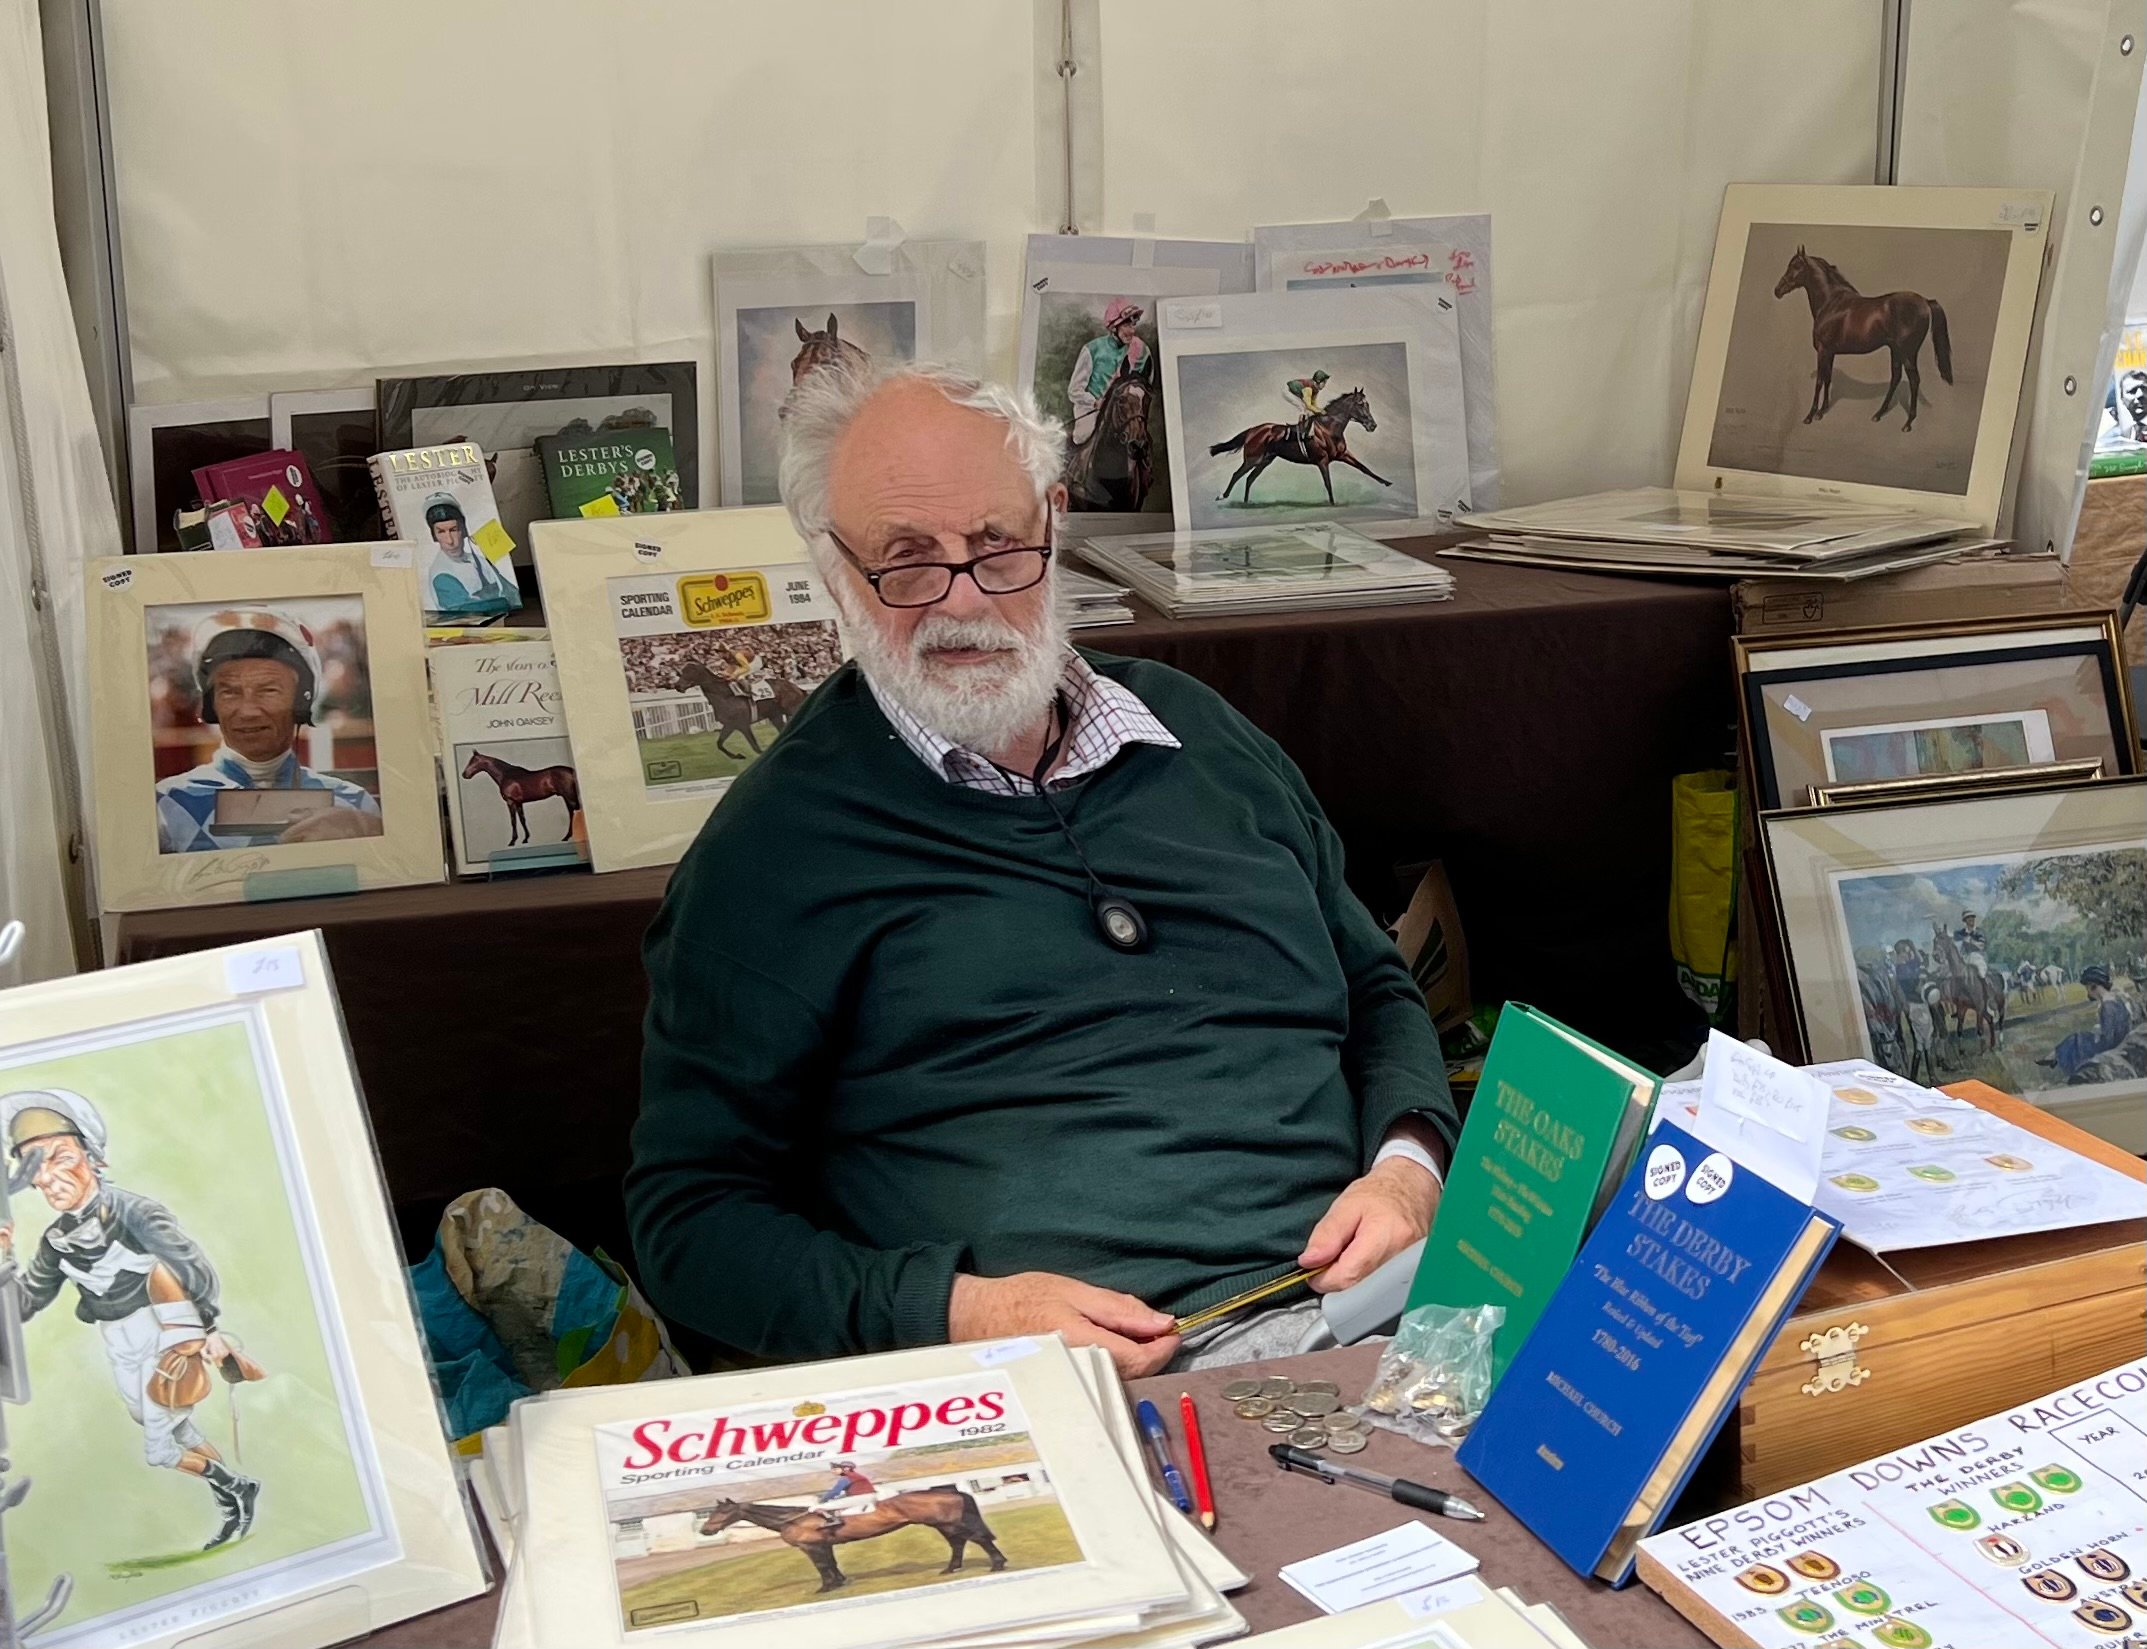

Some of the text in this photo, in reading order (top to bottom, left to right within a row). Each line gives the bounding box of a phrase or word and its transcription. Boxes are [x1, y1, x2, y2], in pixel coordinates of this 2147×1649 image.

[389, 446, 478, 472] LESTER
[558, 445, 633, 462] LESTER'S
[561, 461, 629, 478] DERBYS
[109, 577, 131, 588] COPY
[785, 581, 810, 592] JUNE
[620, 592, 670, 605] SPORTING
[621, 605, 674, 618] CALENDAR
[694, 585, 756, 616] Schweppes
[475, 657, 502, 676] The
[518, 680, 563, 714] Ree
[487, 716, 555, 729] JOHN OAKSEY
[1496, 1079, 1586, 1161] THE OAKS
[1493, 1118, 1565, 1183] STAKES
[1650, 1160, 1681, 1178] SIGNED
[1653, 1174, 1677, 1188] COPY
[1700, 1164, 1726, 1189] SIGNED
[1696, 1176, 1717, 1195] COPY
[1627, 1190, 1752, 1284] THE DERBY
[1626, 1233, 1711, 1300] STAKES
[2007, 1367, 2147, 1434] RACECO
[623, 1391, 1005, 1469] Schweppes
[959, 1422, 1008, 1437] 1982
[2077, 1426, 2121, 1445] YEAR
[620, 1449, 826, 1485] Sporting Calendar
[1849, 1432, 1989, 1491] DOWNS
[1905, 1446, 2025, 1494] THE DERBY
[1937, 1461, 2025, 1496] WINNERS
[1679, 1486, 1831, 1550] EPSOM
[1987, 1503, 2066, 1532] HARZAND
[1677, 1508, 1851, 1573] LESTER PIGGOTT'S
[1686, 1516, 1867, 1584] NINE DERBY WINNERS
[2018, 1530, 2130, 1575] GOLDEN HORN
[1794, 1570, 1873, 1599] TEENOSO
[1818, 1600, 1939, 1641] THE MINTREL
